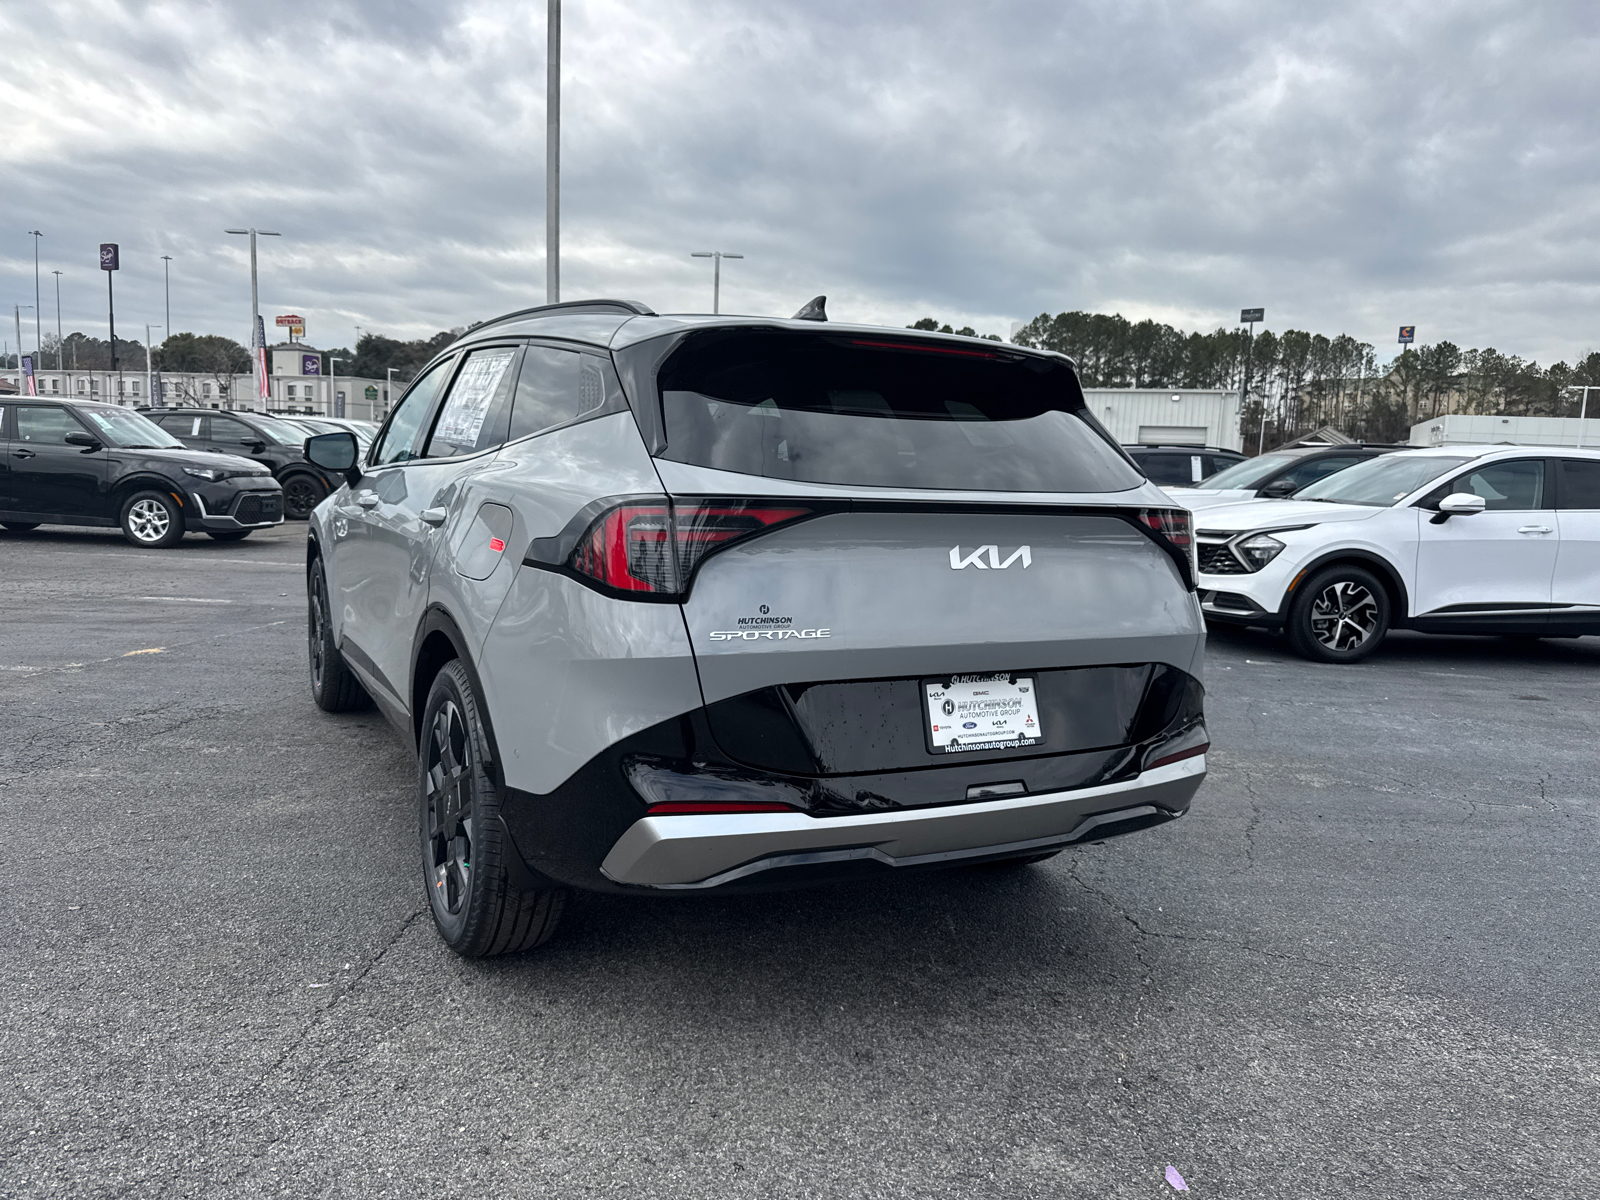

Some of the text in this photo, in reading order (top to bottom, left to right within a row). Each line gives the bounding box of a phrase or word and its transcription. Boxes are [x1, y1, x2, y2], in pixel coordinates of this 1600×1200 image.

[949, 544, 1032, 570] KIA
[737, 616, 793, 625] HUTCHINSON
[709, 628, 831, 641] SPORTAGE
[958, 698, 1022, 713] HUTCHINSON
[960, 709, 999, 719] AUTOMOTIVE
[958, 730, 1015, 739] HUTCHINSONAUTOGROUP.COM
[945, 738, 1036, 753] Hutchinsonautogroup.com
